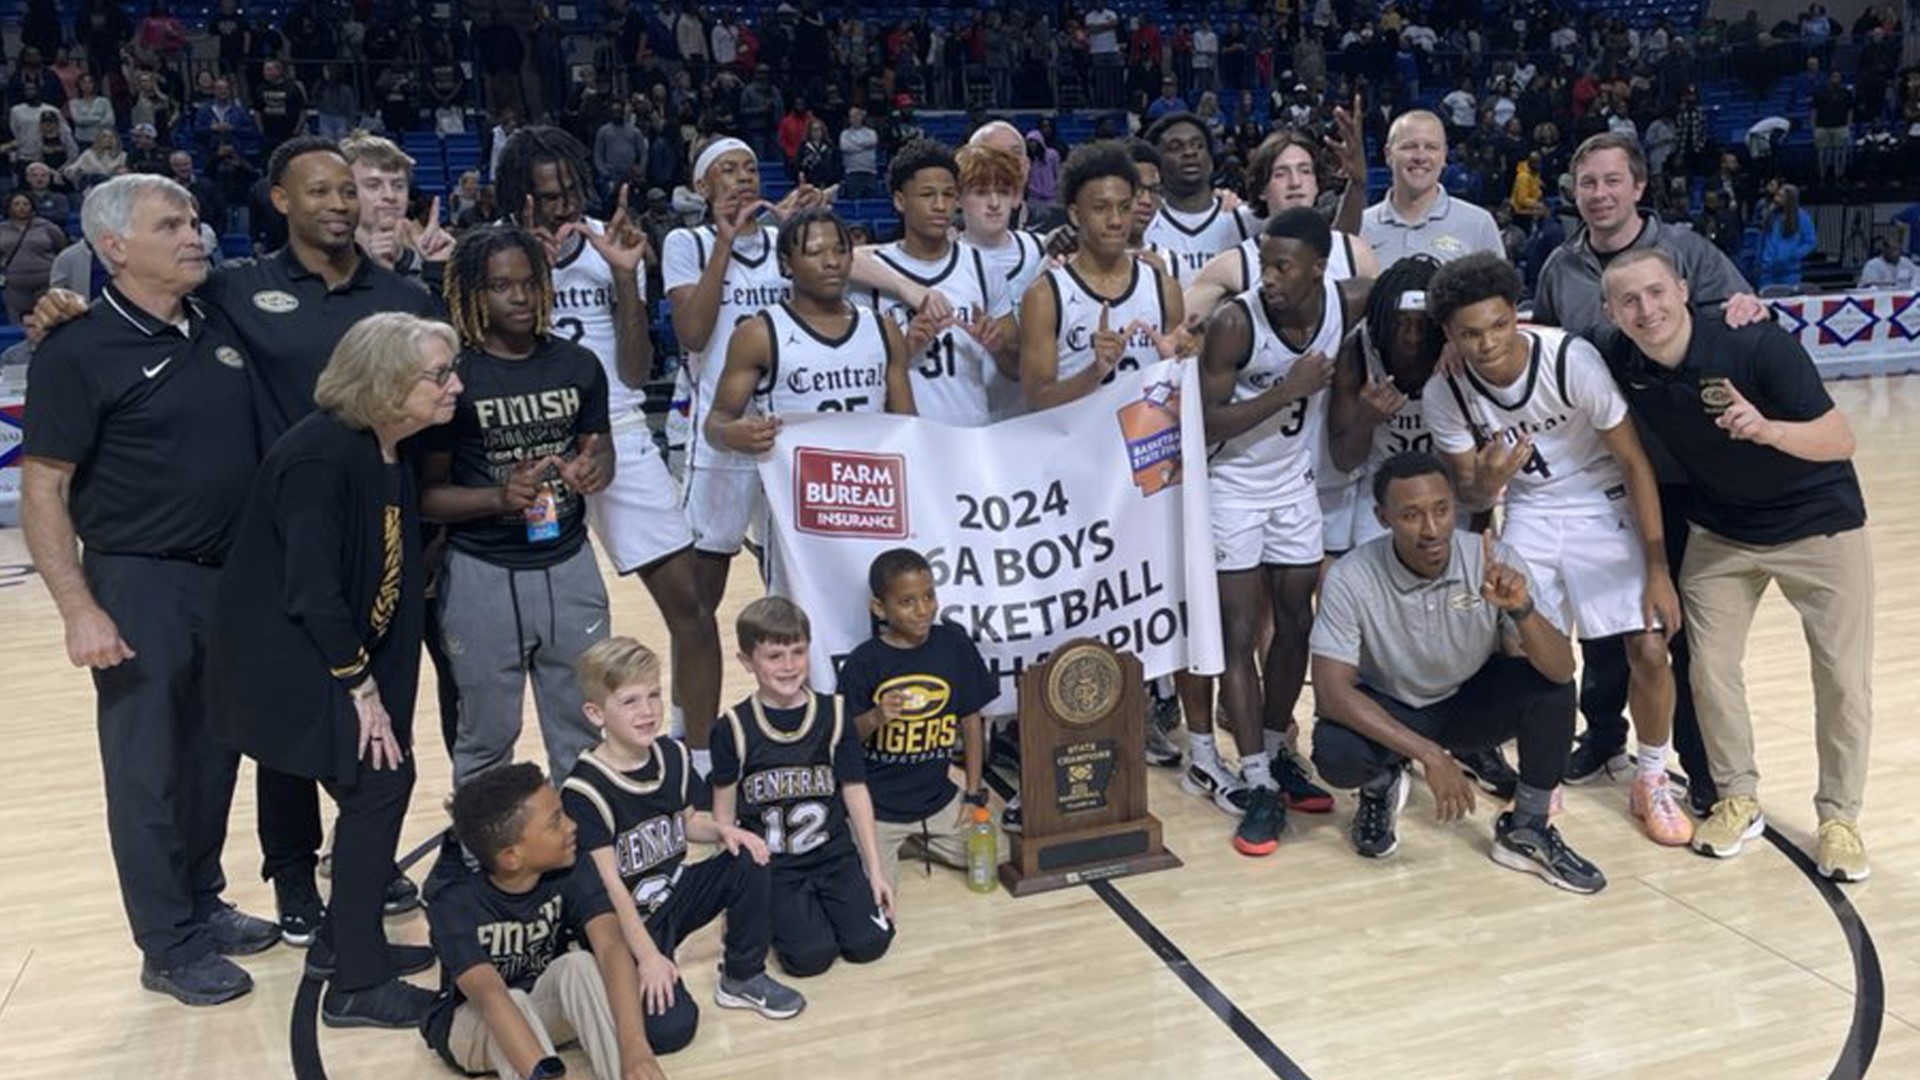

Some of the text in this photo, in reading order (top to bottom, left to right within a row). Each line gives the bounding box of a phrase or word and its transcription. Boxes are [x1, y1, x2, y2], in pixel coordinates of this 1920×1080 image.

[919, 332, 955, 379] 31
[787, 362, 883, 394] Central
[474, 387, 580, 428] FINISH
[806, 482, 895, 507] BUREAU
[831, 463, 893, 485] FARM
[817, 512, 896, 529] INSURANCE
[956, 480, 1069, 532] 2024
[925, 520, 1115, 588] 6A BOYS
[940, 560, 1163, 643] SKETBALL
[876, 713, 957, 754] IGERS
[761, 801, 831, 855] 12
